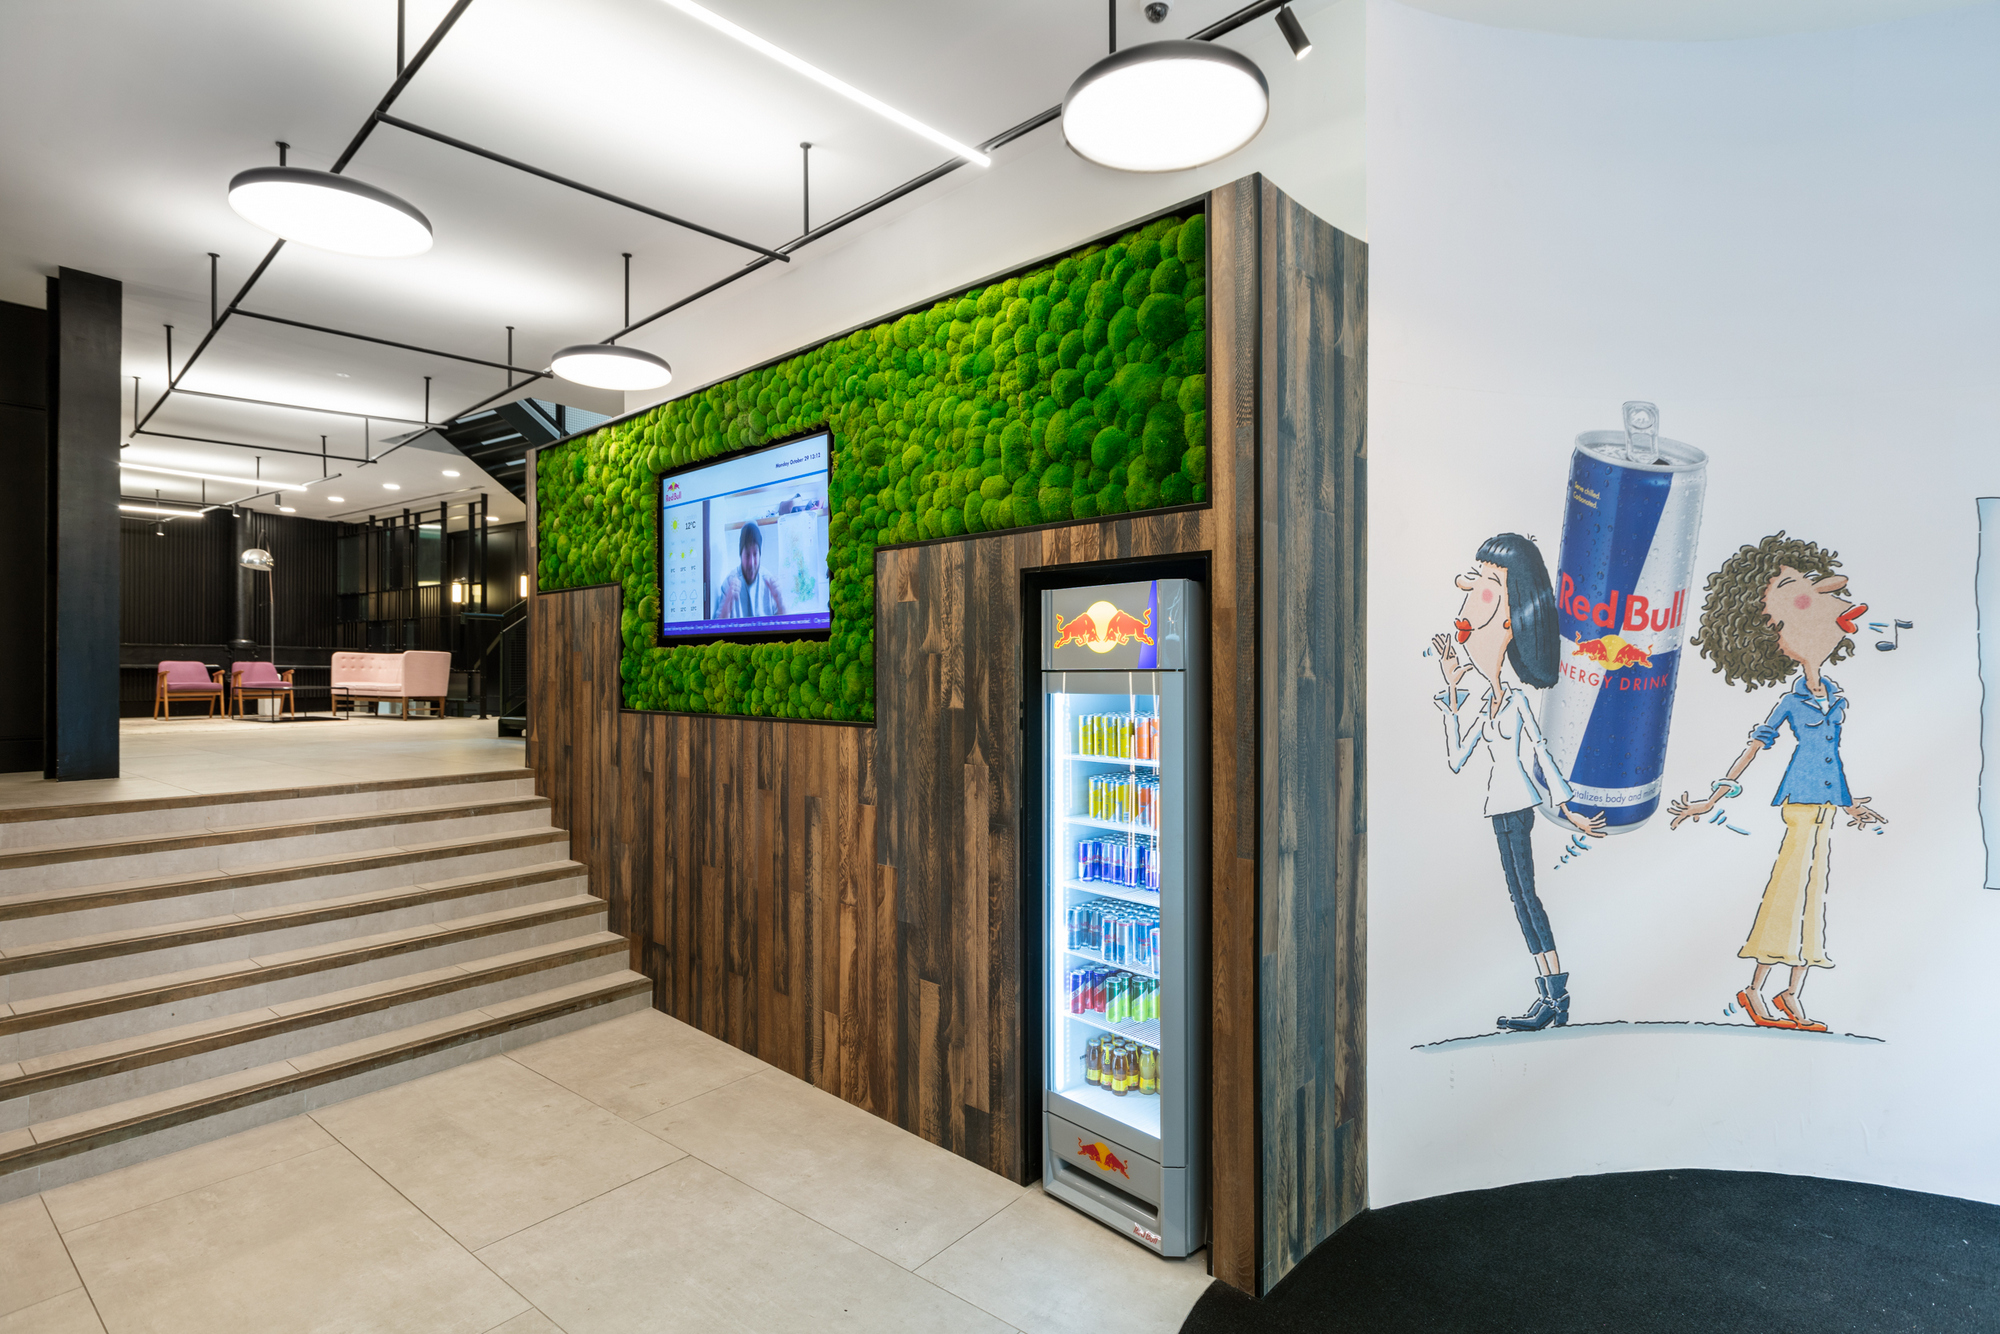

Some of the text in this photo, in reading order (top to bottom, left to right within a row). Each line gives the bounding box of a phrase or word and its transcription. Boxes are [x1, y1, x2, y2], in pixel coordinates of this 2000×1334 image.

[1573, 491, 1598, 509] Carbonated.
[1574, 480, 1601, 500] Serve chilled.
[1559, 571, 1686, 632] Red Bull
[1560, 660, 1669, 690] NERGY DRINK
[1606, 793, 1626, 805] body
[1628, 790, 1642, 801] and
